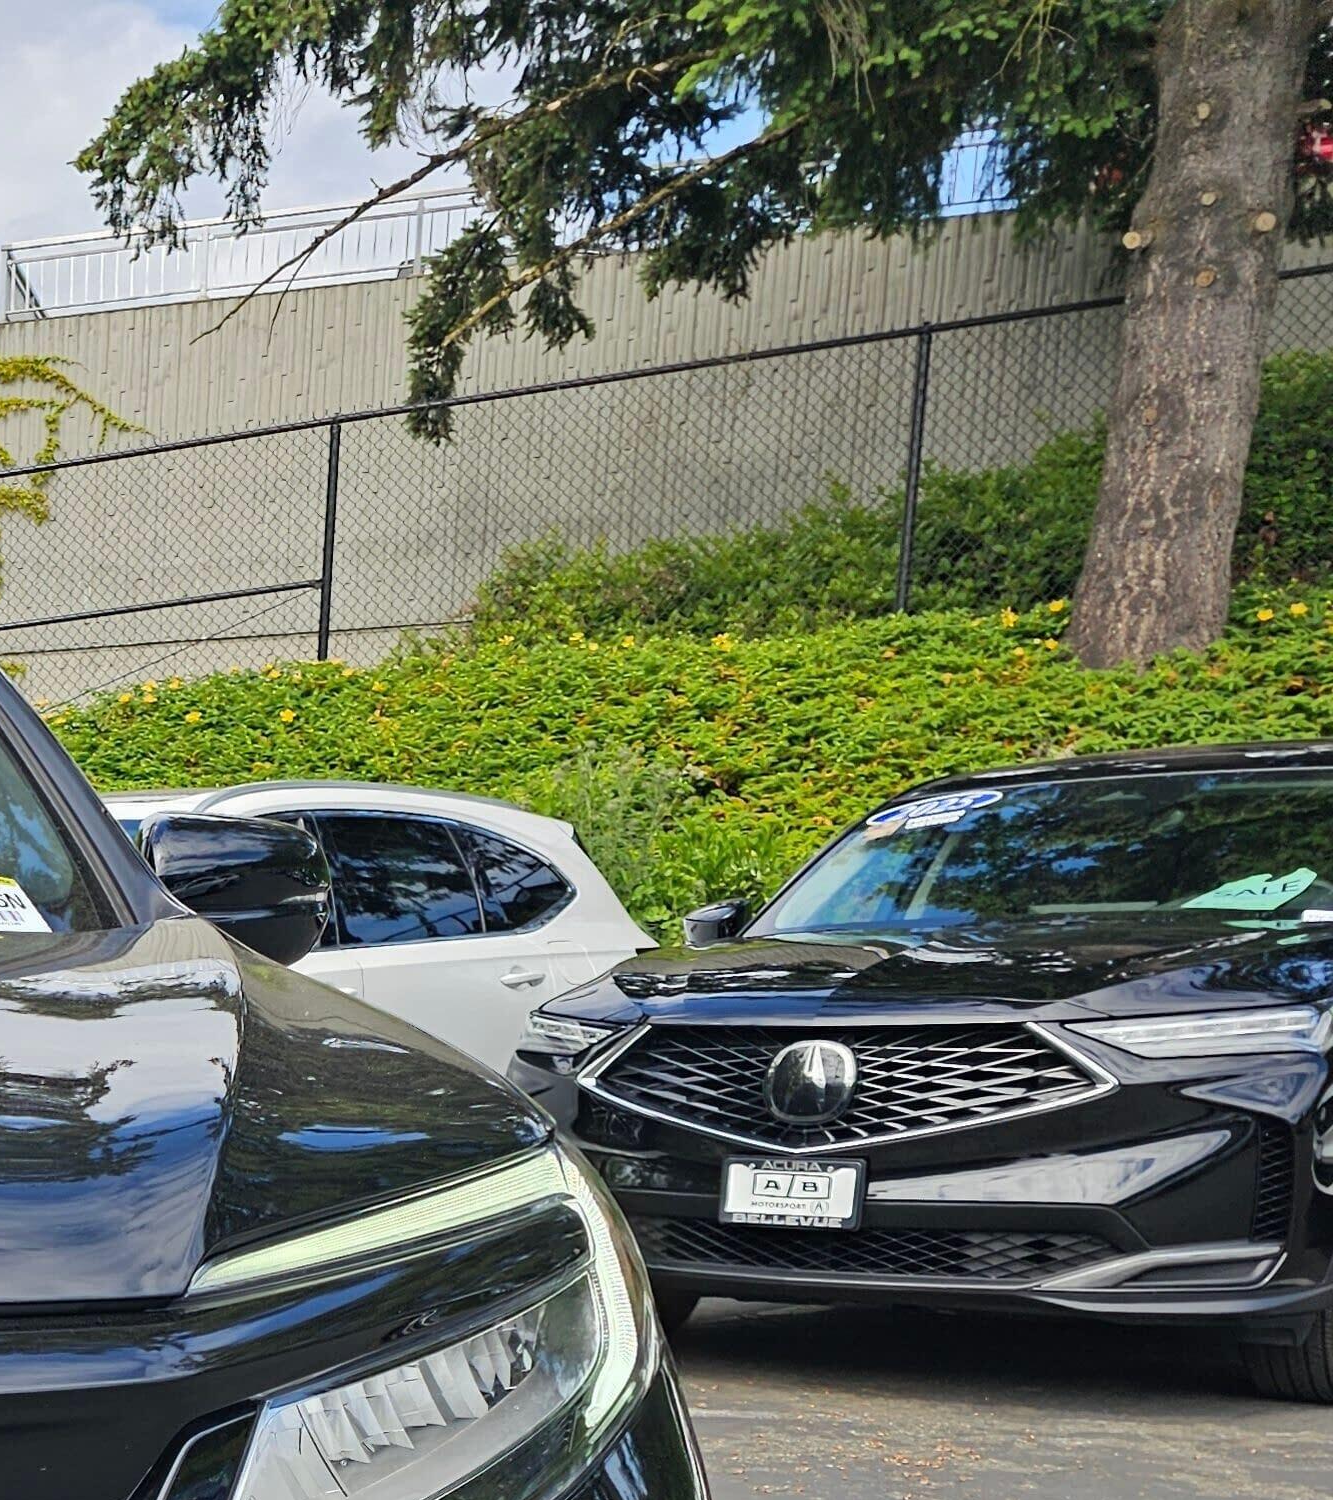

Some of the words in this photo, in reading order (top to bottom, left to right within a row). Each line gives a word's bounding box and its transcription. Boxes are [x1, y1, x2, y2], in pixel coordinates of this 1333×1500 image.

[761, 1160, 822, 1172] ACURA
[750, 1201, 807, 1210] MOTORSPORT
[731, 1213, 844, 1228] BELLEVUE
